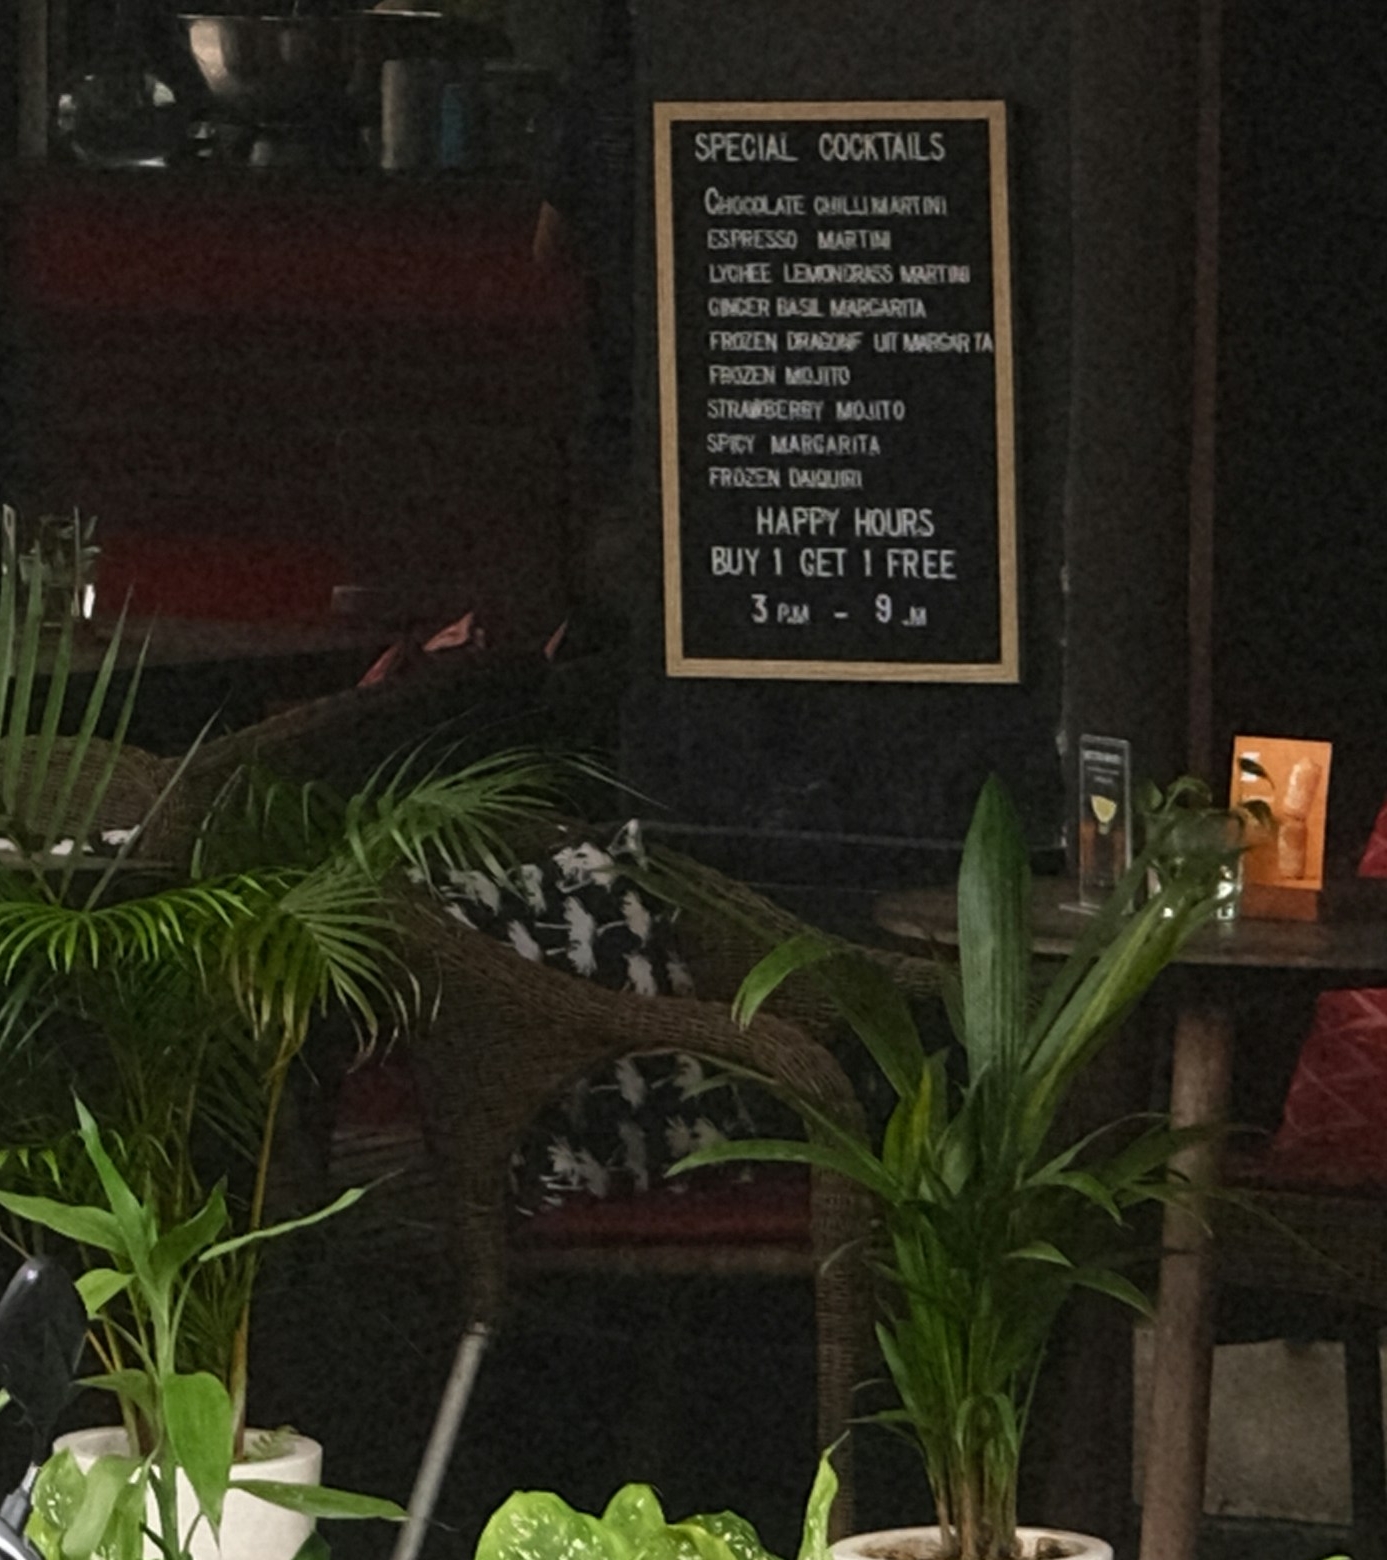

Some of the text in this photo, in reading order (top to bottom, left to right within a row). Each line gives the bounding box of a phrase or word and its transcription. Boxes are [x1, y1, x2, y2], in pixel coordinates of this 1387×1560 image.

[695, 132, 946, 162] SPECIAL COCKTAILS
[707, 230, 891, 250] ESPRESSO MARTINI
[709, 264, 772, 283] LYCHEE
[707, 298, 770, 317] GINGER
[829, 298, 927, 318] MARGARITA
[709, 331, 777, 352] FROZEN
[709, 365, 851, 386] FROZEN MOJITO
[836, 400, 906, 421] MOJITO
[706, 433, 881, 455] SPICY MARGARITA
[709, 467, 780, 488] FROZEN
[757, 506, 935, 537] HAPPY HOURS
[710, 546, 957, 579] BUY 1 GET 1 FREE
[751, 594, 768, 624] 3
[875, 593, 892, 623] 9
